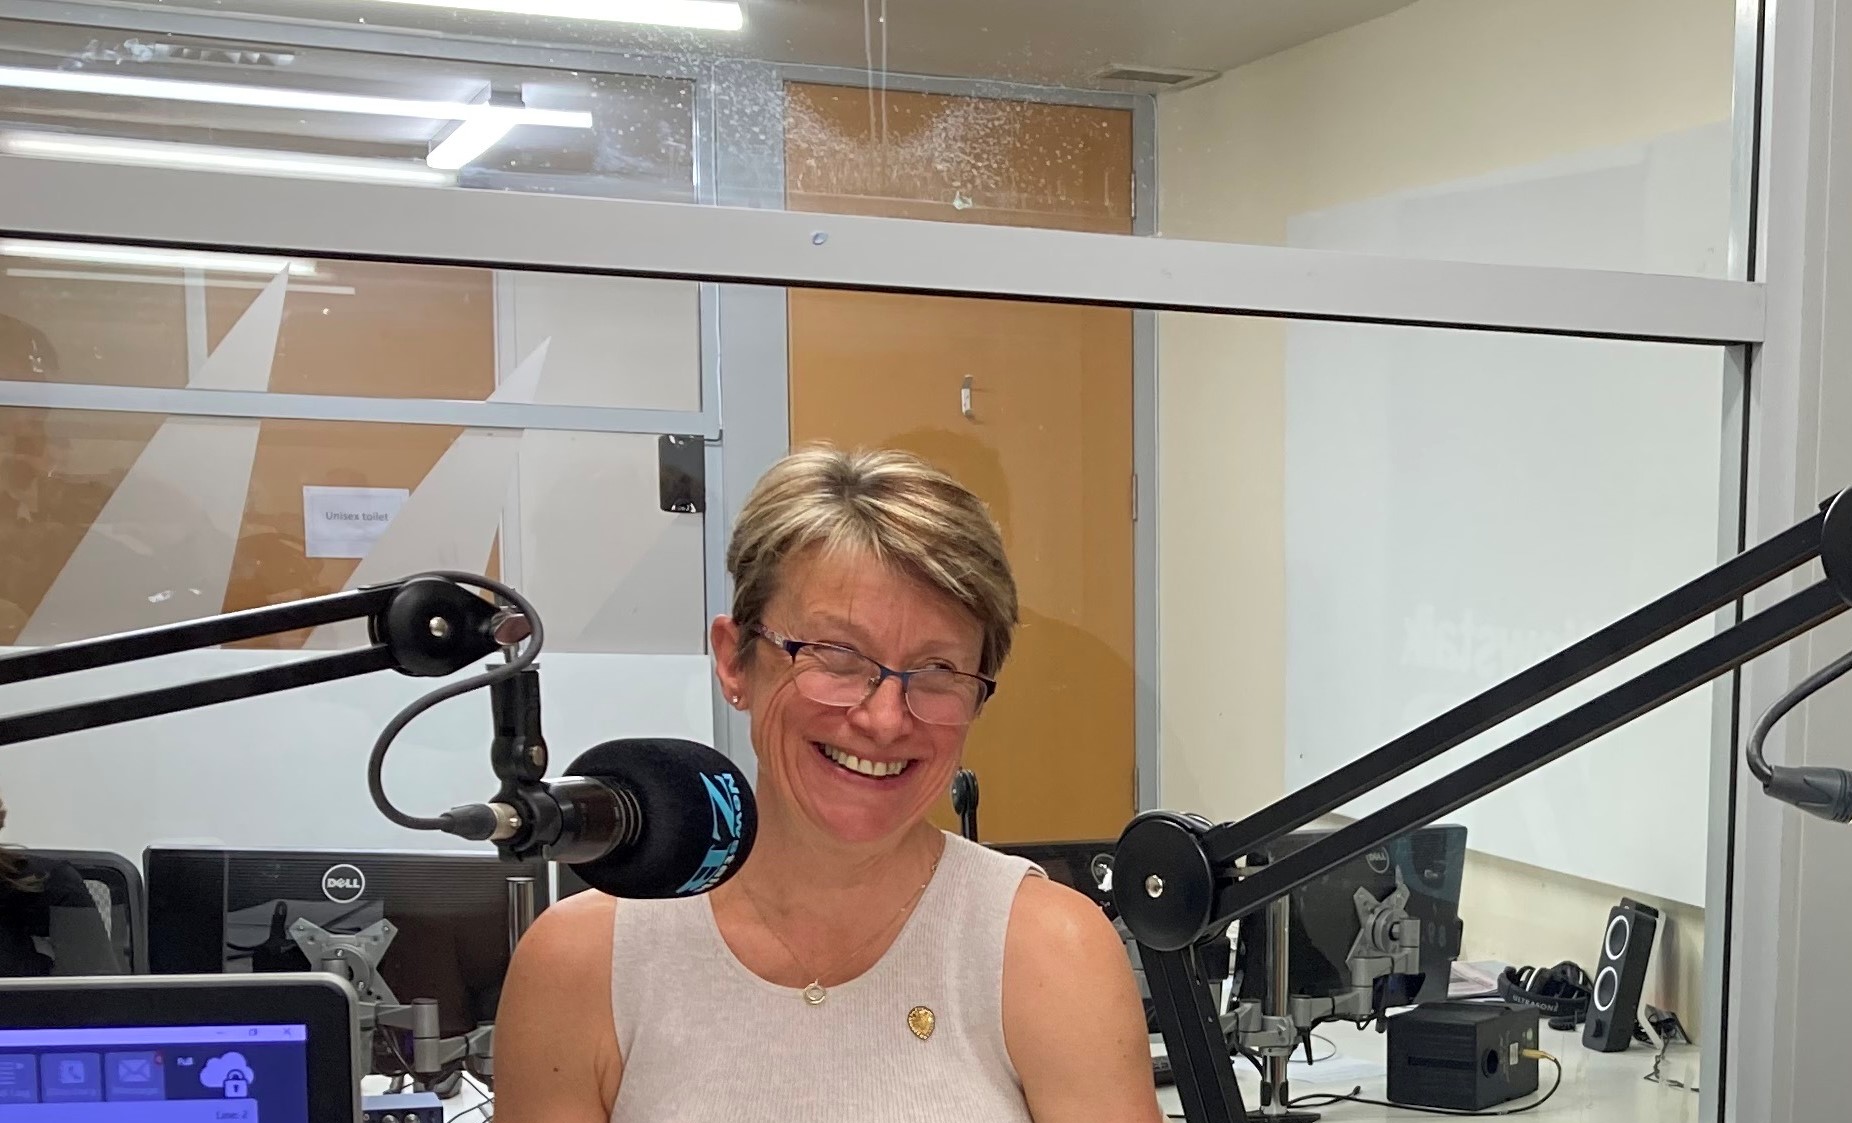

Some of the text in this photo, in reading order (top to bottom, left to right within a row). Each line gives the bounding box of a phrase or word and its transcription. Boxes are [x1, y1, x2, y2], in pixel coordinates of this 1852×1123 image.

[325, 511, 389, 522] Unisex toilet
[676, 772, 736, 893] ZB
[327, 877, 361, 889] DELL
